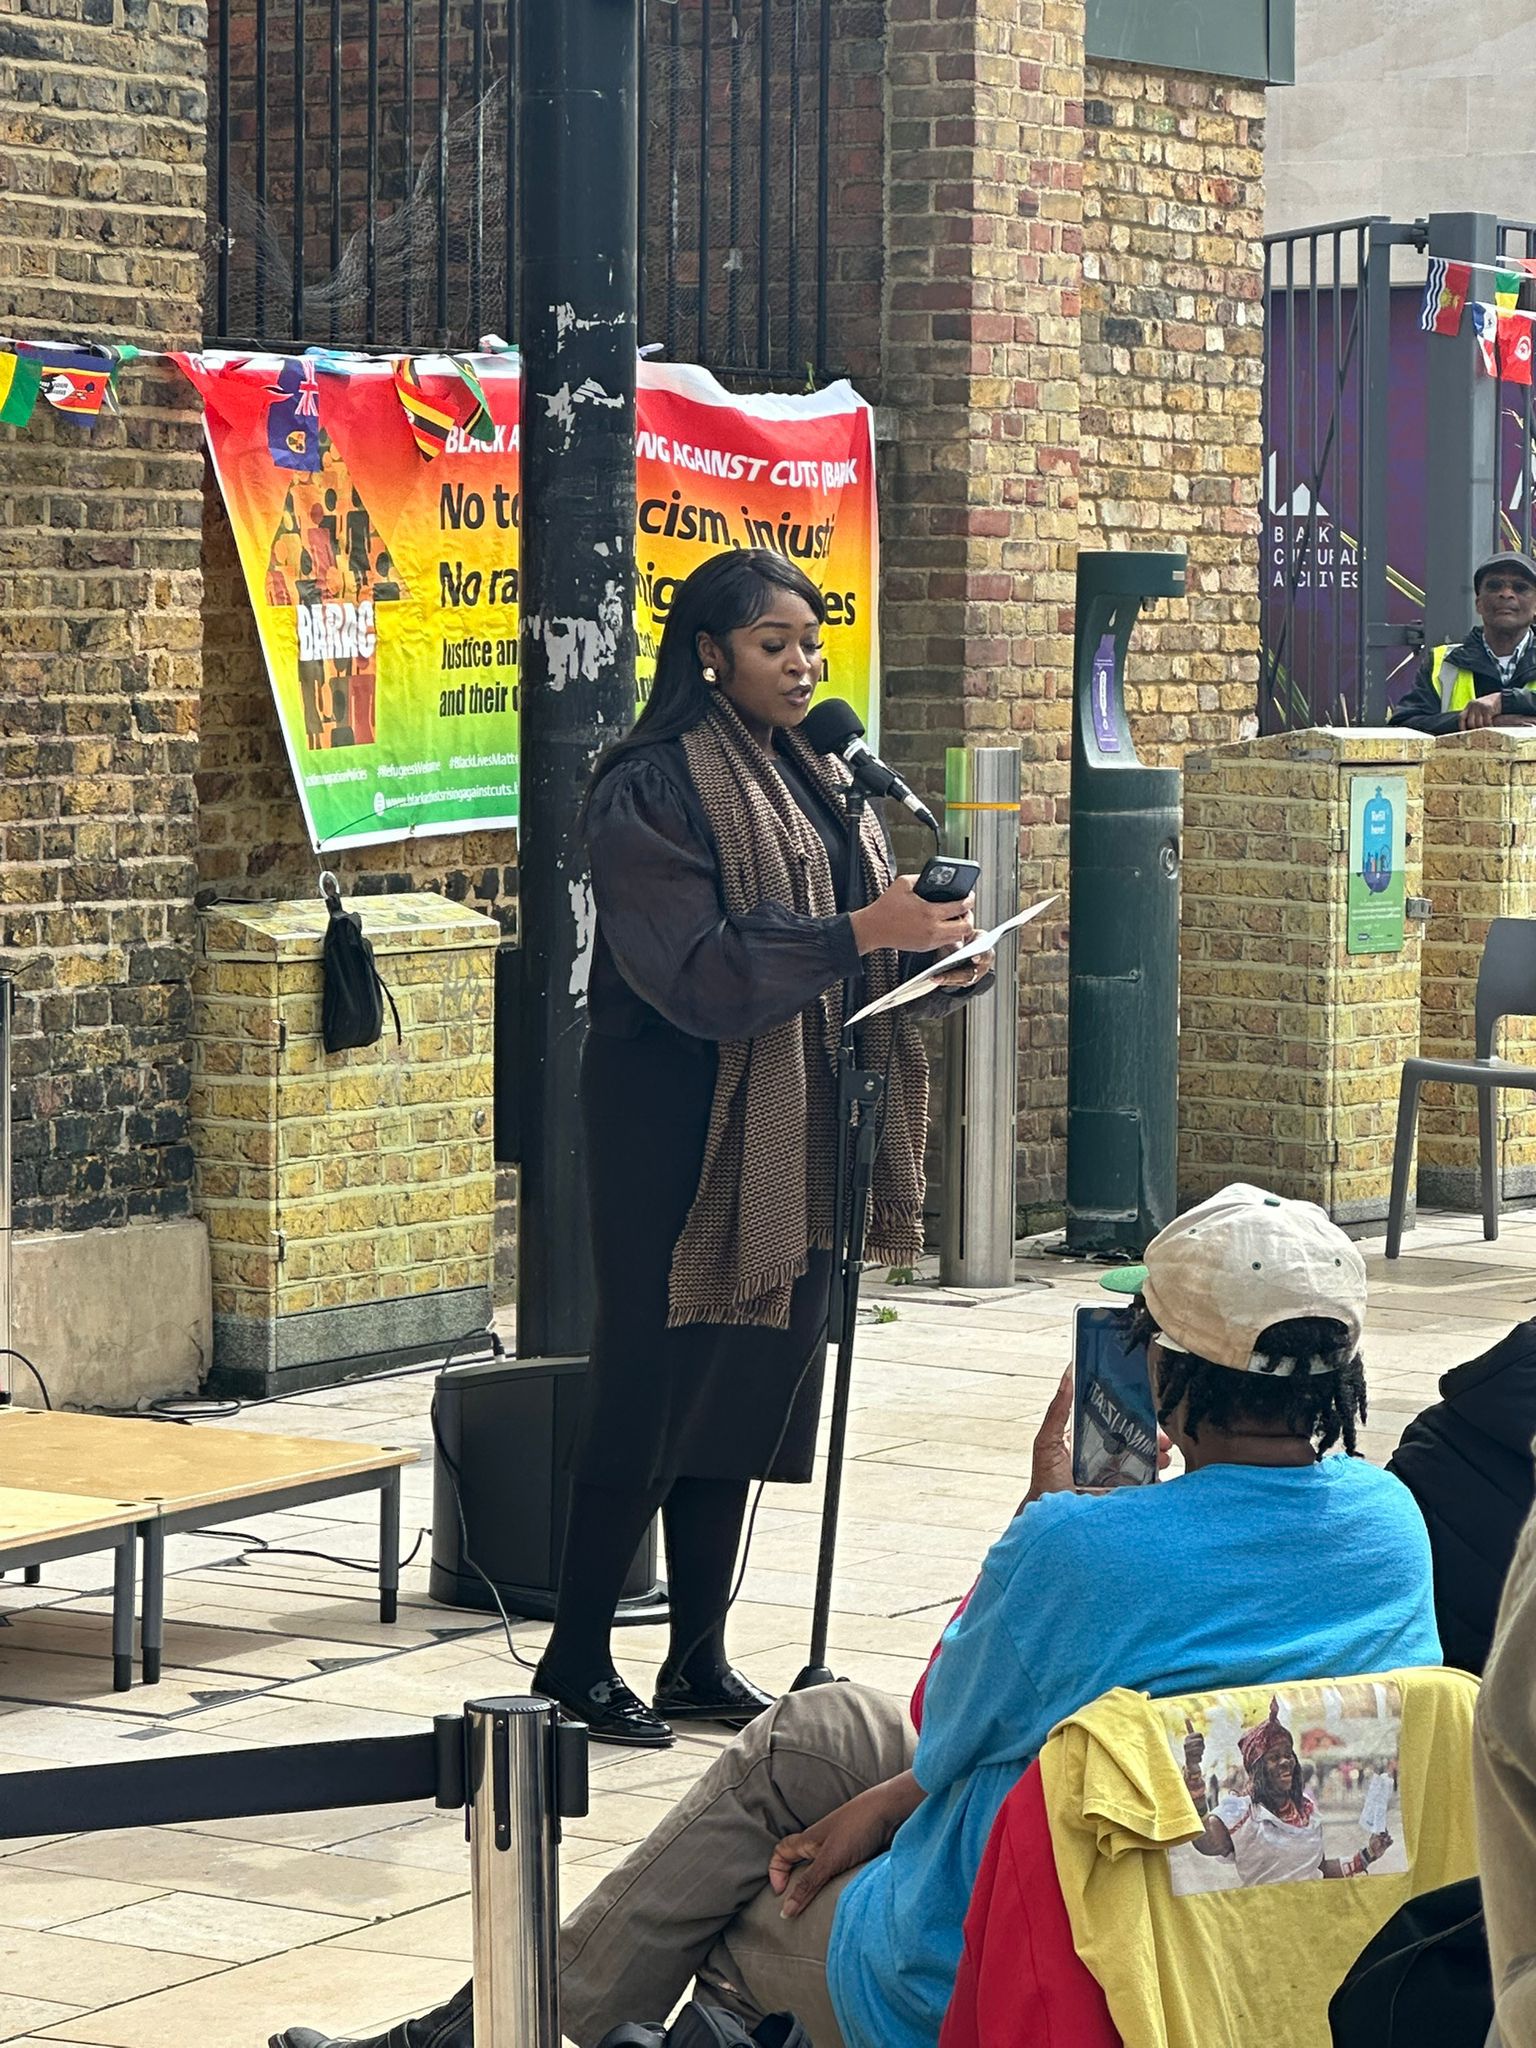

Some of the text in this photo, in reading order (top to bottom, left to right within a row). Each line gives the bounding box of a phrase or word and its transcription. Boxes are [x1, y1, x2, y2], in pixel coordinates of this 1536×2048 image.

[673, 440, 768, 482] AGAINST
[769, 460, 819, 488] CUTS
[440, 483, 485, 530] No
[439, 561, 482, 608] No
[297, 600, 376, 661] BARAC
[441, 637, 492, 670] Justice
[439, 683, 466, 717] and
[469, 681, 508, 714] their
